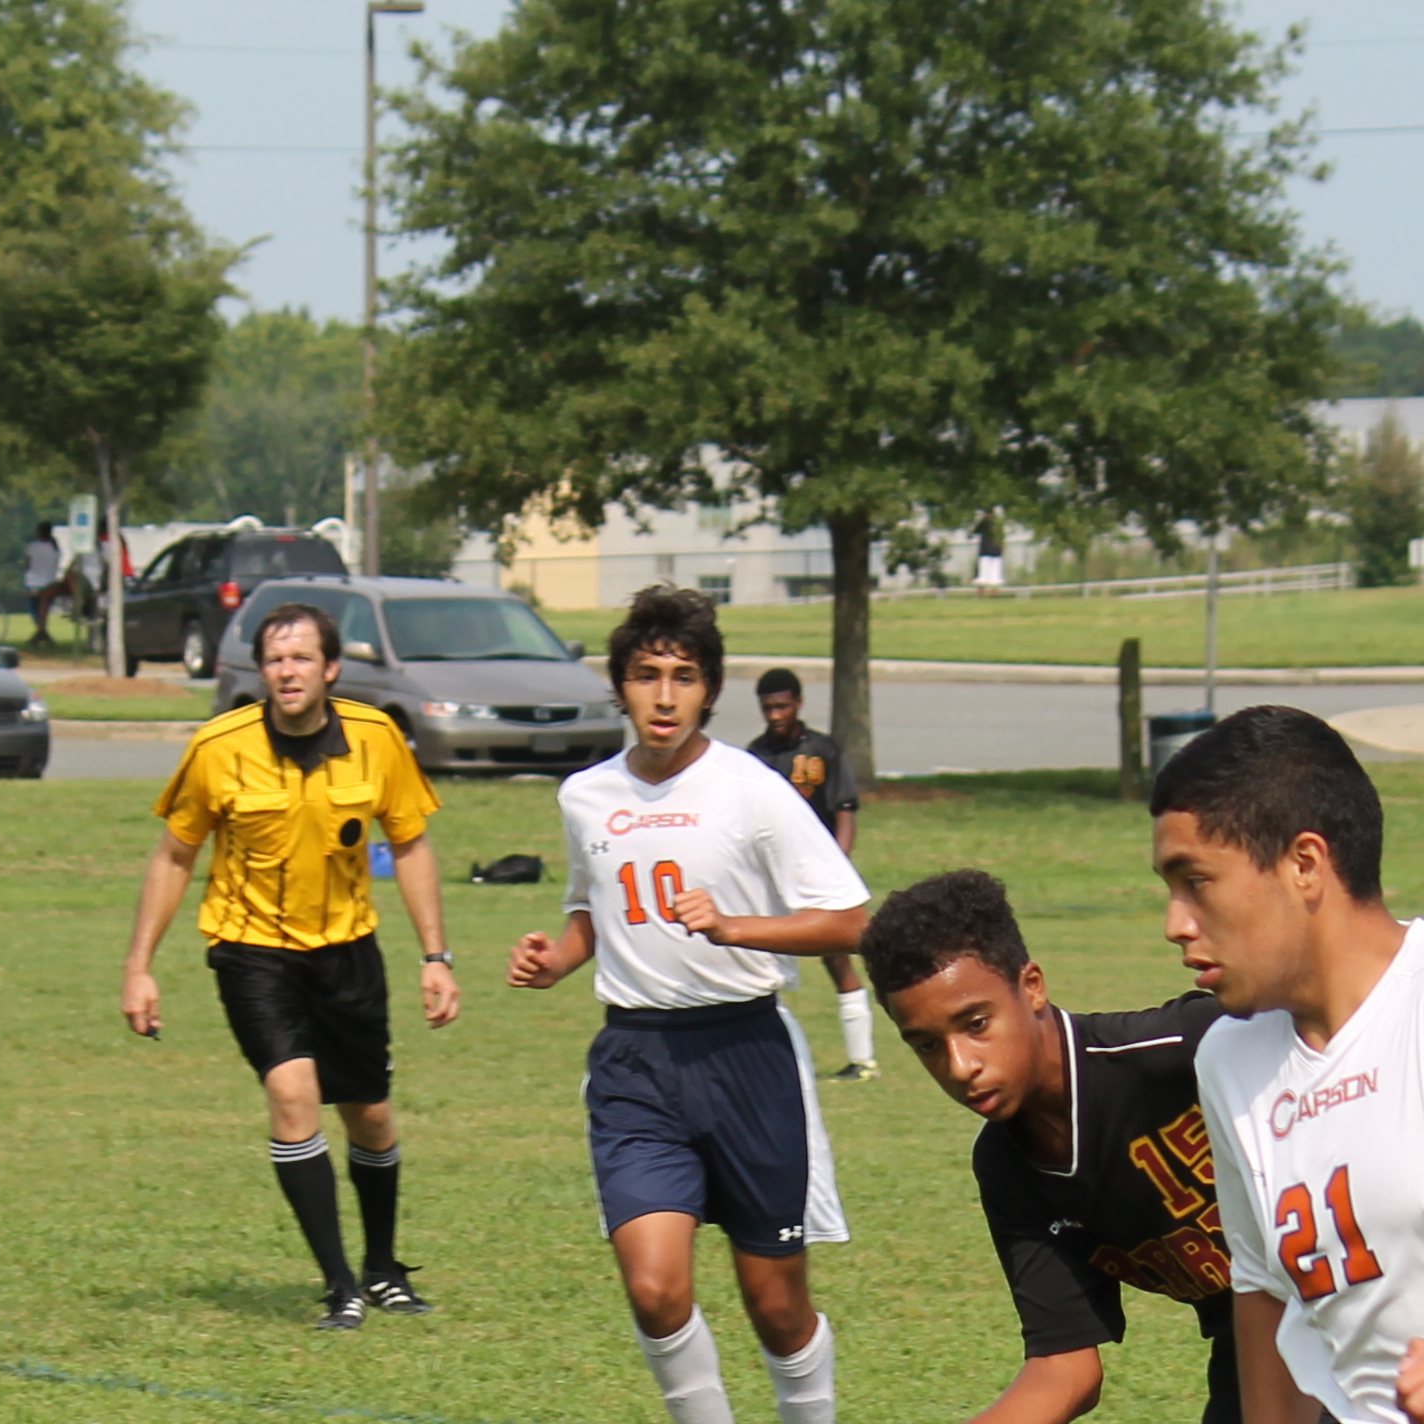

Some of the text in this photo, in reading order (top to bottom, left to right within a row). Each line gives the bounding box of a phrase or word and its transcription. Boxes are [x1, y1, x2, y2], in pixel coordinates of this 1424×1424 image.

[605, 808, 700, 836] CARSON
[617, 859, 684, 925] 10
[1267, 1067, 1379, 1141] CARSON
[1274, 1163, 1384, 1302] 21
